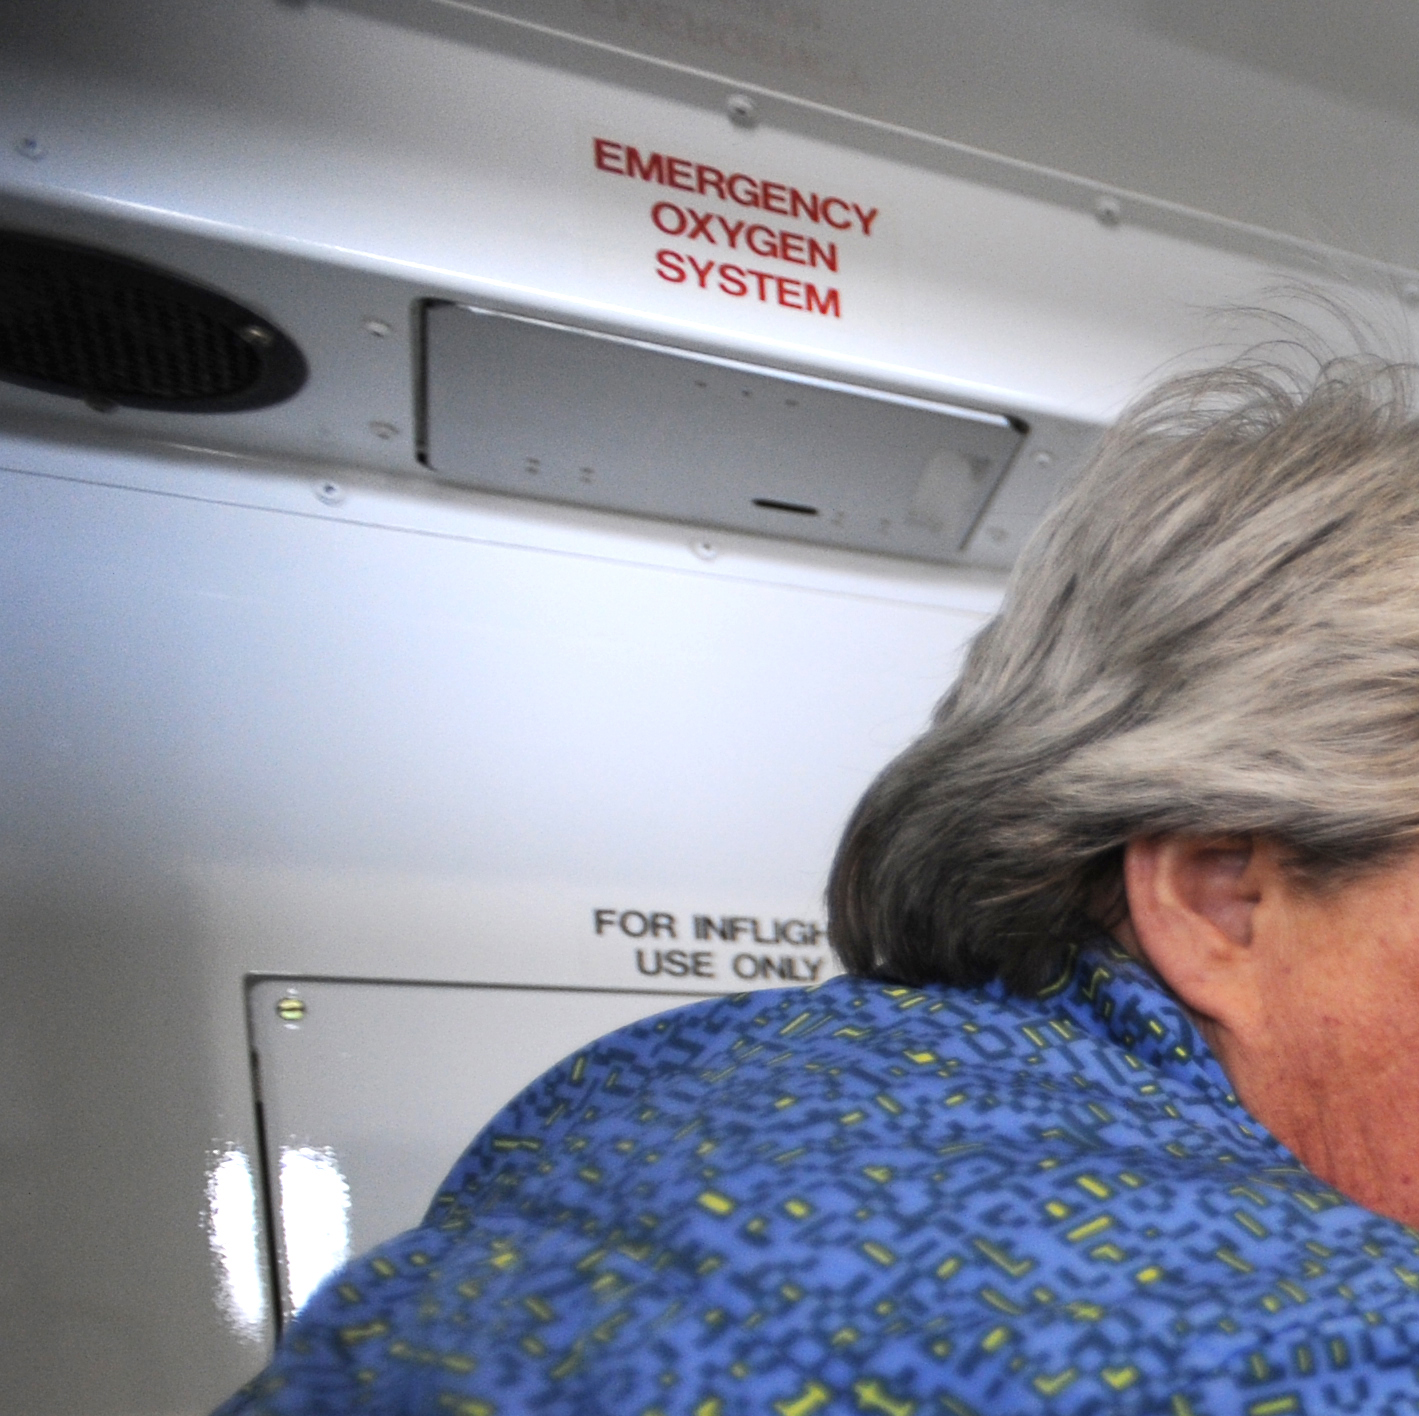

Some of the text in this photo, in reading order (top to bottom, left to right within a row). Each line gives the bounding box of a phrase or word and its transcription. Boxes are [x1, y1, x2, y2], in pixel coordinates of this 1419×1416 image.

[593, 137, 878, 236] EMERGENCY
[651, 201, 838, 272] OXYGEN
[655, 249, 841, 318] SYSTEM
[593, 909, 829, 945] FOR INFLIGH
[636, 949, 824, 981] USE ONLY
